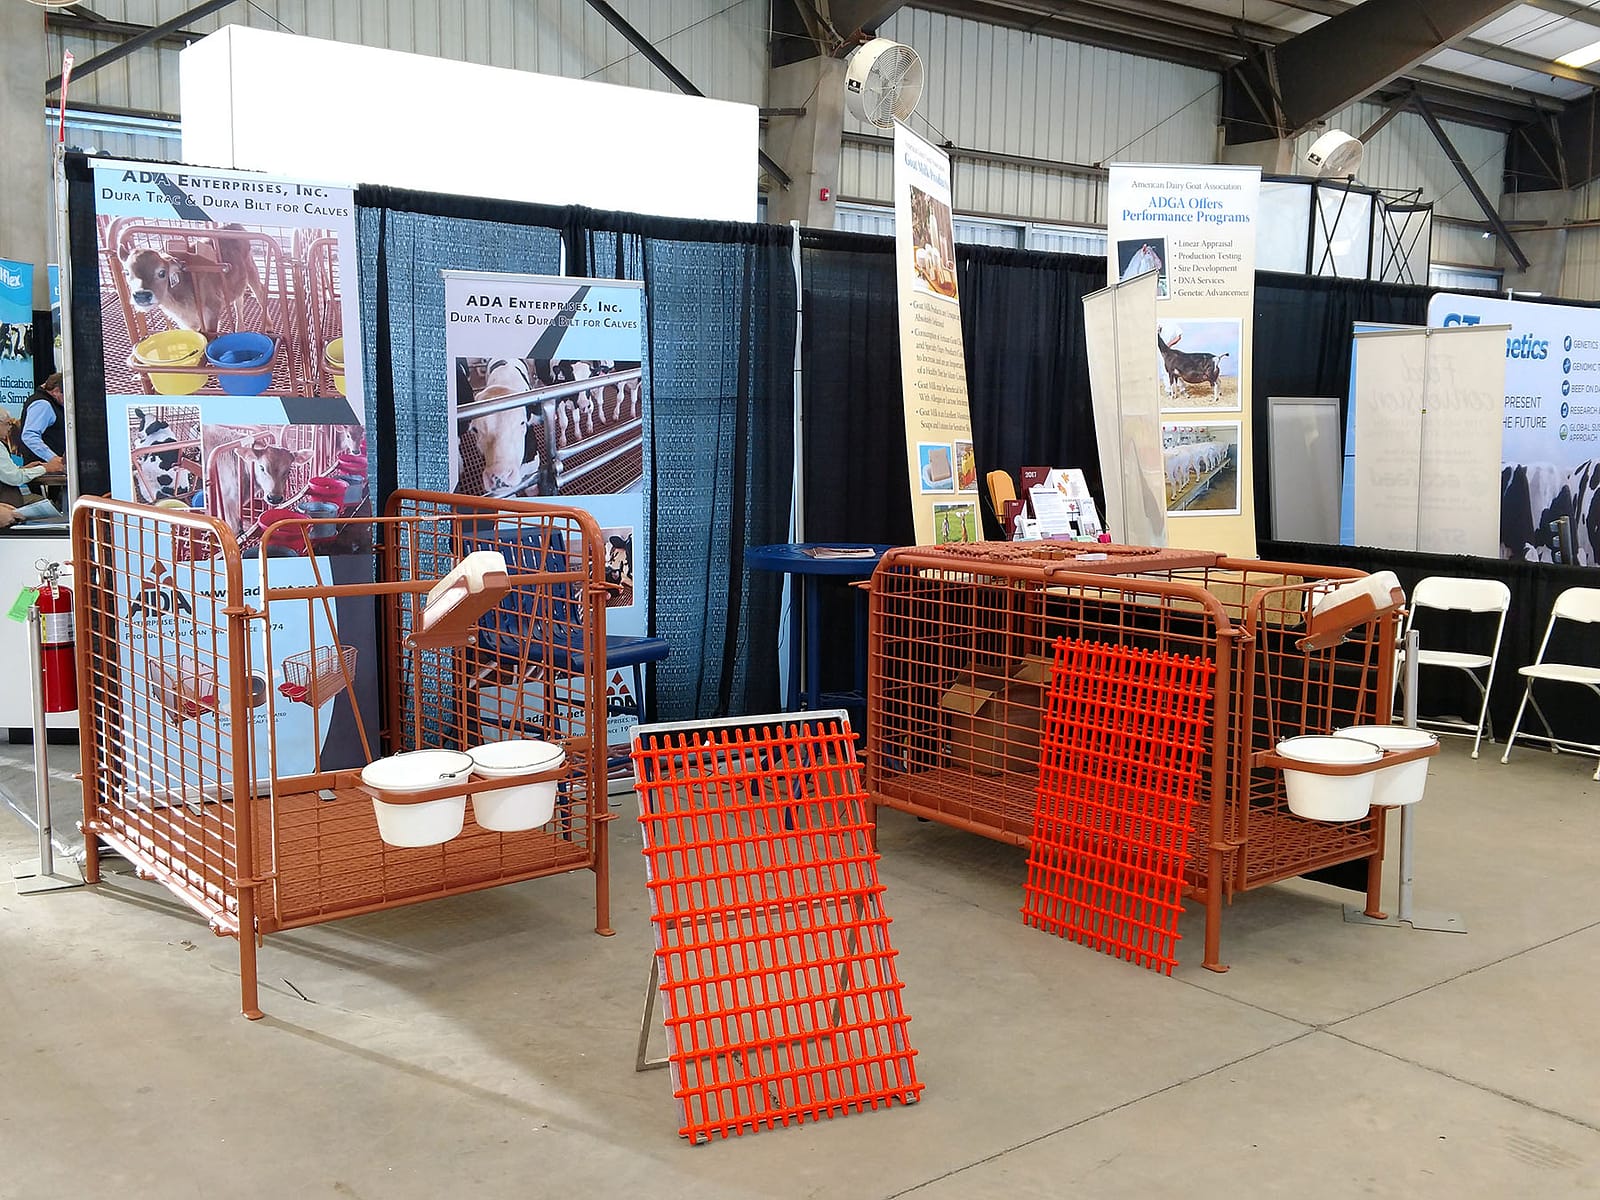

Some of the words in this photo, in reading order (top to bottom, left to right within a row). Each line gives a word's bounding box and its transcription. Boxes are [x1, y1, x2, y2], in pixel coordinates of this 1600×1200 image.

[122, 170, 169, 185] ADA
[296, 184, 328, 199] INC.
[1131, 181, 1164, 189] American
[1166, 181, 1184, 191] Dairy
[1186, 181, 1202, 190] Goat
[1204, 182, 1242, 191] Association
[101, 188, 141, 202] DURA
[146, 190, 181, 205] TRAC
[184, 194, 197, 207] &
[202, 195, 240, 210] DURA
[244, 198, 271, 211] BILT
[276, 202, 299, 214] FOR
[304, 202, 349, 218] CALVES
[1148, 196, 1185, 209] ADGA
[1188, 197, 1224, 210] Offers
[1122, 209, 1194, 223] Performance
[1197, 210, 1251, 226] Programs
[1178, 239, 1200, 248] Linear
[1201, 239, 1233, 250] Appraisal
[1178, 252, 1215, 260] Production
[1217, 252, 1242, 261] Testing
[1178, 264, 1190, 272] Sire
[1192, 264, 1238, 274] Development
[0, 266, 21, 287] lflex
[1178, 276, 1196, 285] DNA
[1197, 276, 1225, 285] Services
[1178, 288, 1203, 297] Genetic
[466, 295, 503, 309] ADA
[598, 301, 623, 314] INC.
[450, 311, 480, 324] DURA
[484, 313, 510, 325] TRAC
[514, 314, 523, 325] &
[527, 315, 556, 327] DURA
[559, 316, 580, 328] BILT
[583, 319, 600, 329] FOR
[603, 317, 638, 329] CALVES
[1573, 339, 1599, 350] GENETICS
[1572, 362, 1596, 372] GENOMIC
[0, 376, 33, 389] tification
[1571, 384, 1585, 393] BEEF
[1586, 384, 1593, 393] ON
[8, 391, 31, 405] Simpl
[1504, 396, 1542, 409] PRESENT
[1570, 406, 1598, 415] RESEARCH
[1502, 416, 1513, 428] HE
[1515, 416, 1547, 429] FUTURE
[1569, 423, 1591, 432] GLOBAL
[1569, 433, 1598, 442] APPROACH
[125, 589, 193, 619] ADA
